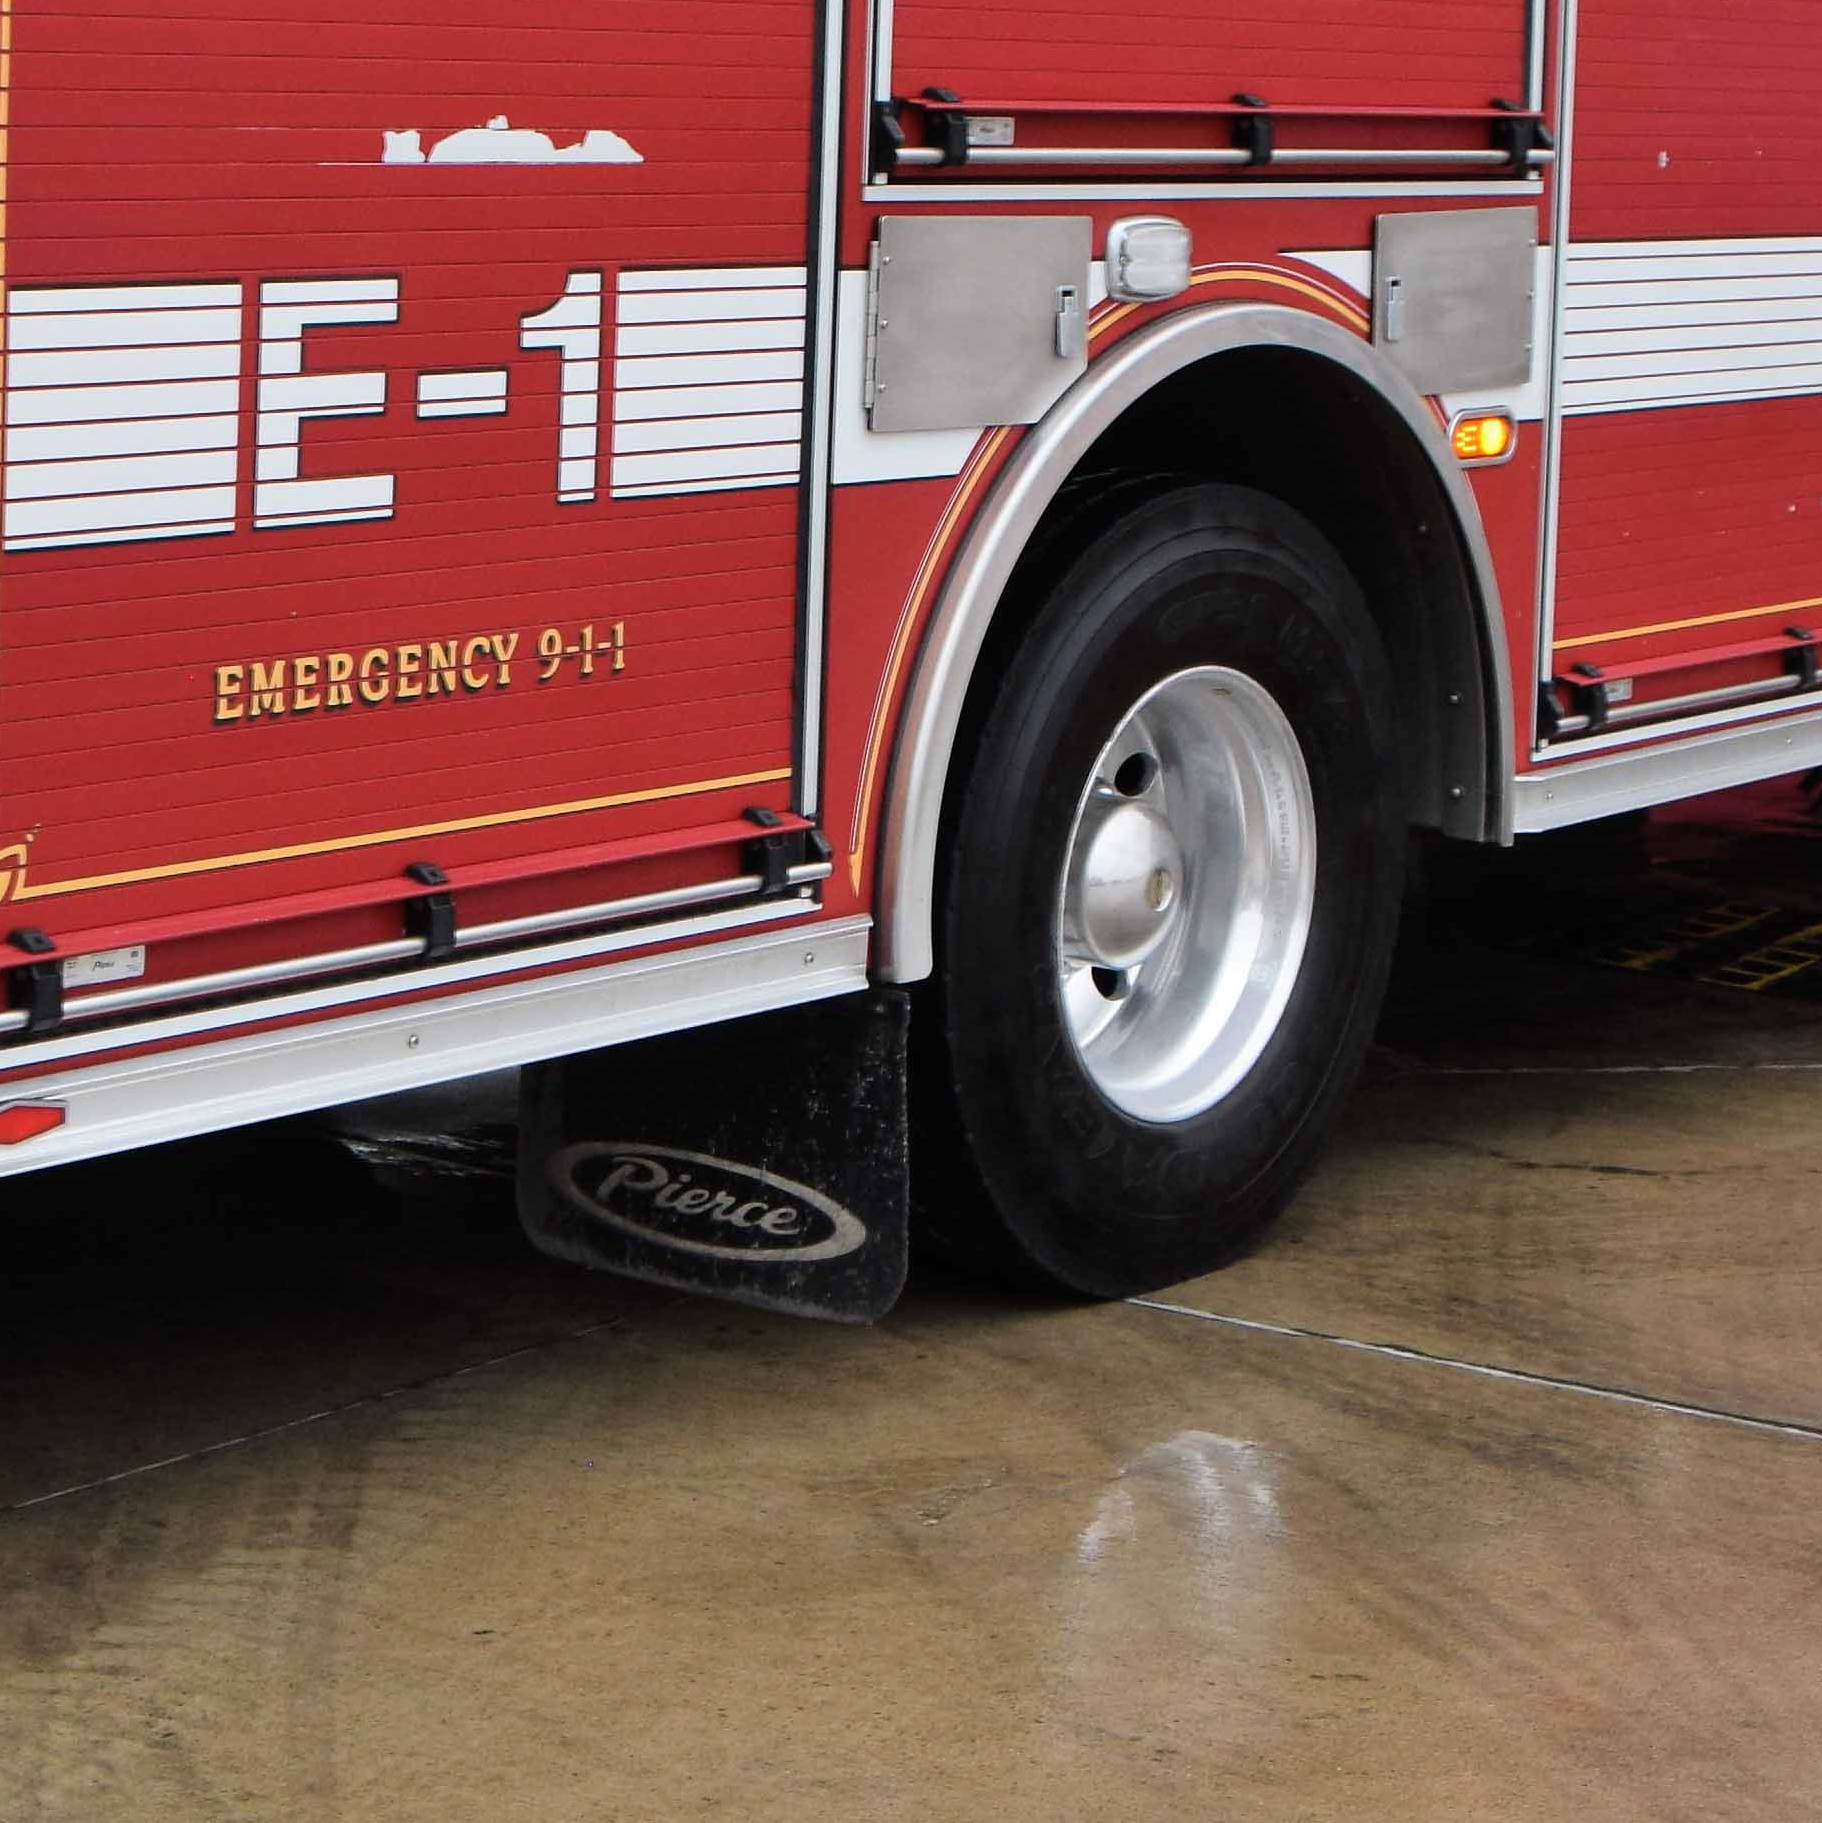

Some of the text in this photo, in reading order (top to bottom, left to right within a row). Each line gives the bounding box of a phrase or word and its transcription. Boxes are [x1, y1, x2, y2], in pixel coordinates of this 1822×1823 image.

[253, 271, 602, 530] E-1
[213, 620, 627, 723] EMERGENCY 9-1-1
[596, 1155, 802, 1236] Pierce
